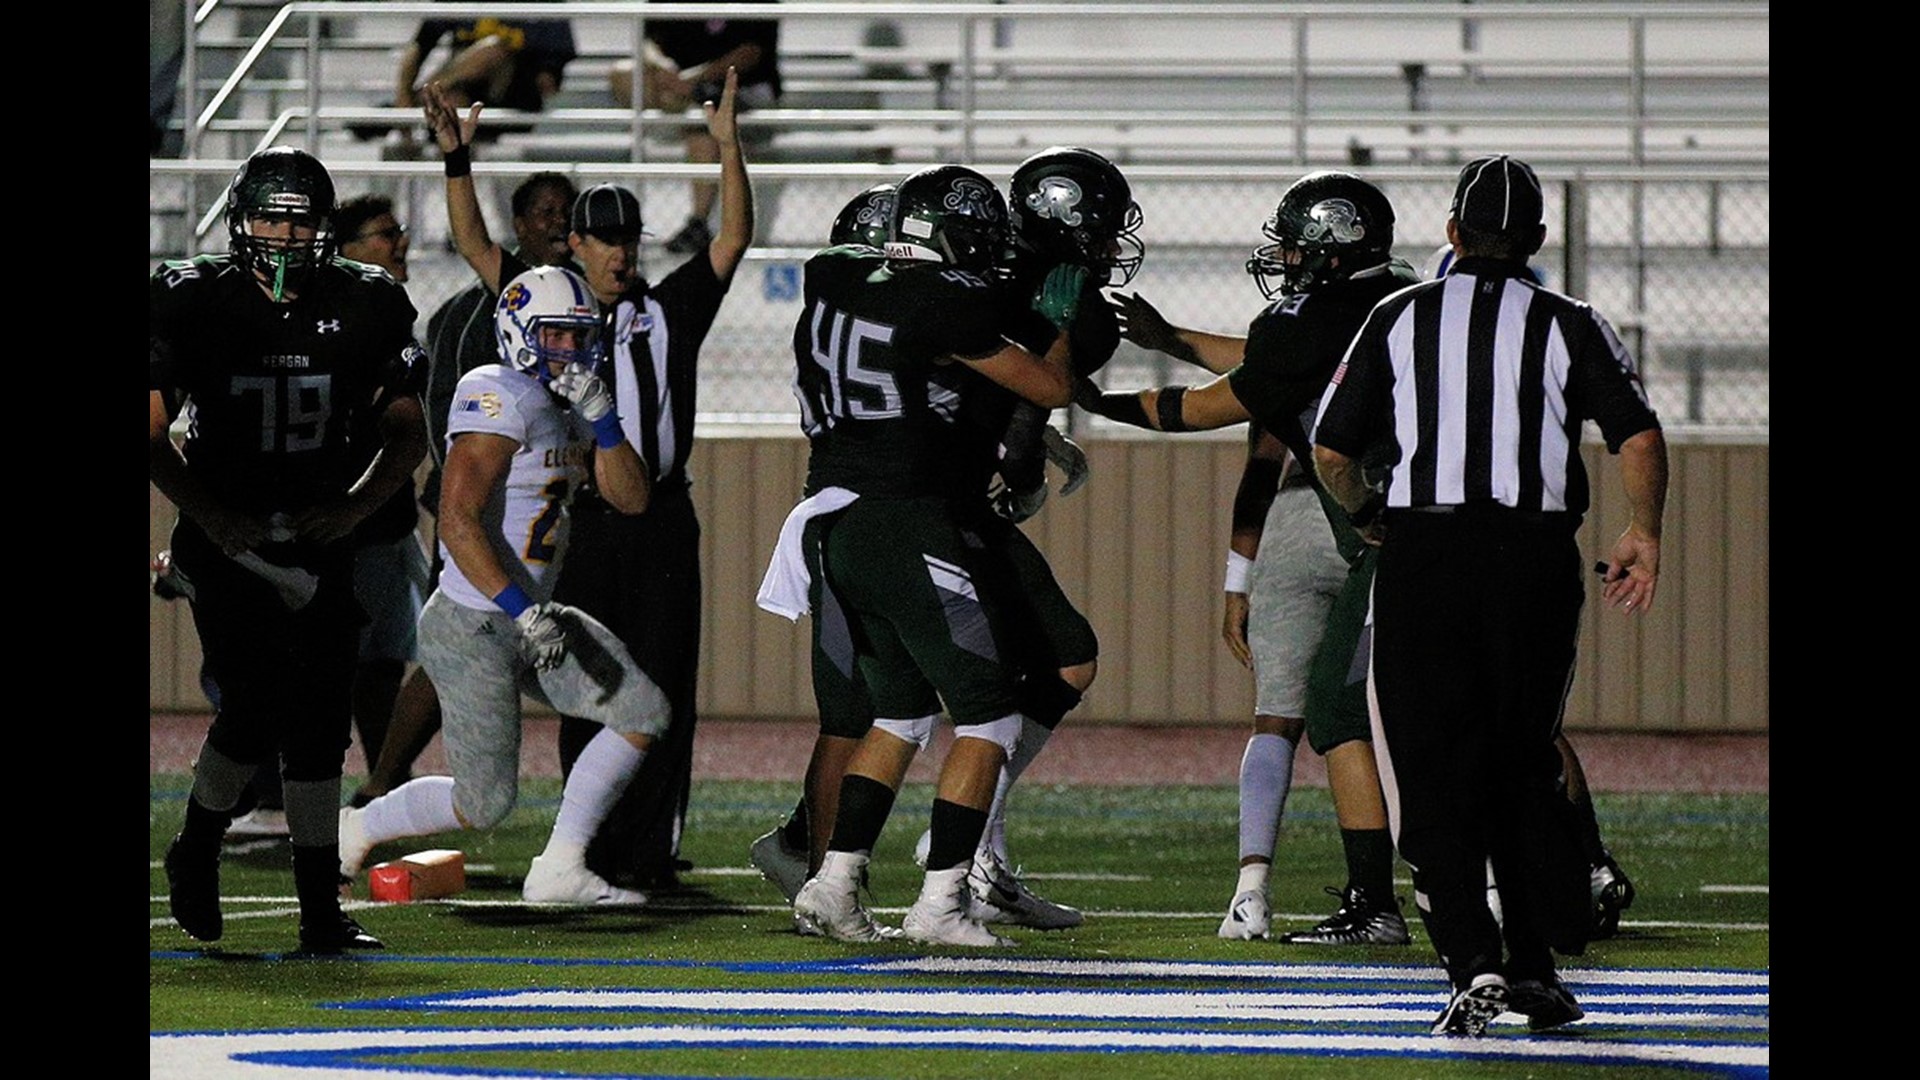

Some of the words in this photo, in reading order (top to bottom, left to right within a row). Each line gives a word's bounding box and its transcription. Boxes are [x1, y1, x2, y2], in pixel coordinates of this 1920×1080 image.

[262, 355, 310, 368] REAGAN
[811, 298, 905, 421] 45
[229, 374, 332, 452] 79
